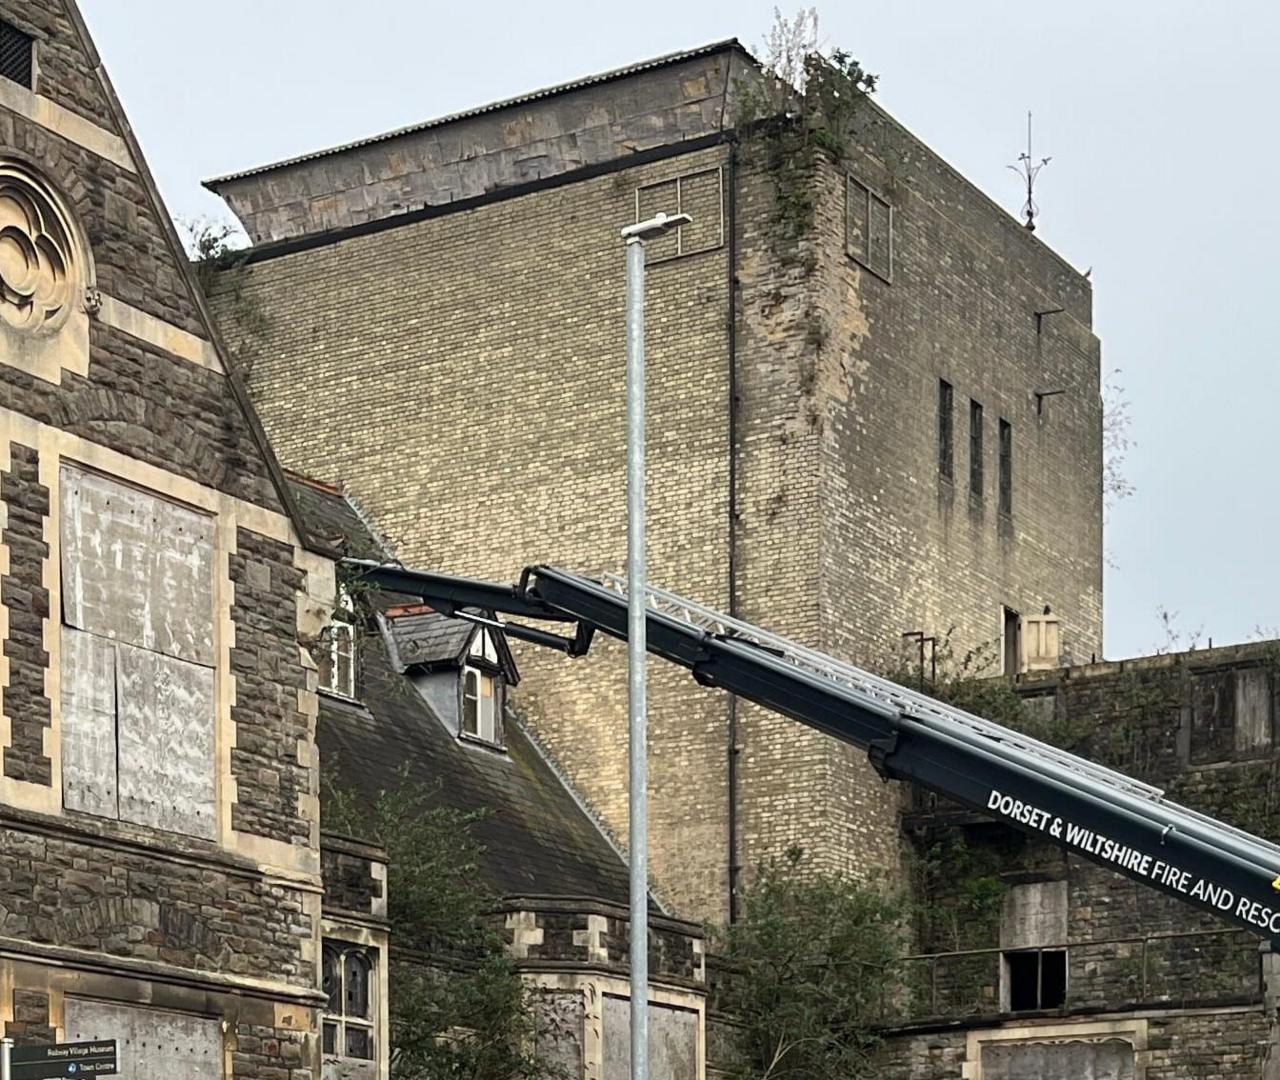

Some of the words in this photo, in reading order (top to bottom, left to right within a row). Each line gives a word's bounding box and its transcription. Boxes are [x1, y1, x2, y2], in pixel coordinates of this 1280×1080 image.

[987, 790, 1051, 831] DORSET
[1049, 817, 1063, 839] &
[1065, 823, 1153, 875] WILTSHIRE
[1151, 861, 1192, 893] FIRE
[1190, 879, 1234, 910] AND
[69, 1046, 89, 1056] Village
[80, 1063, 95, 1072] Town
